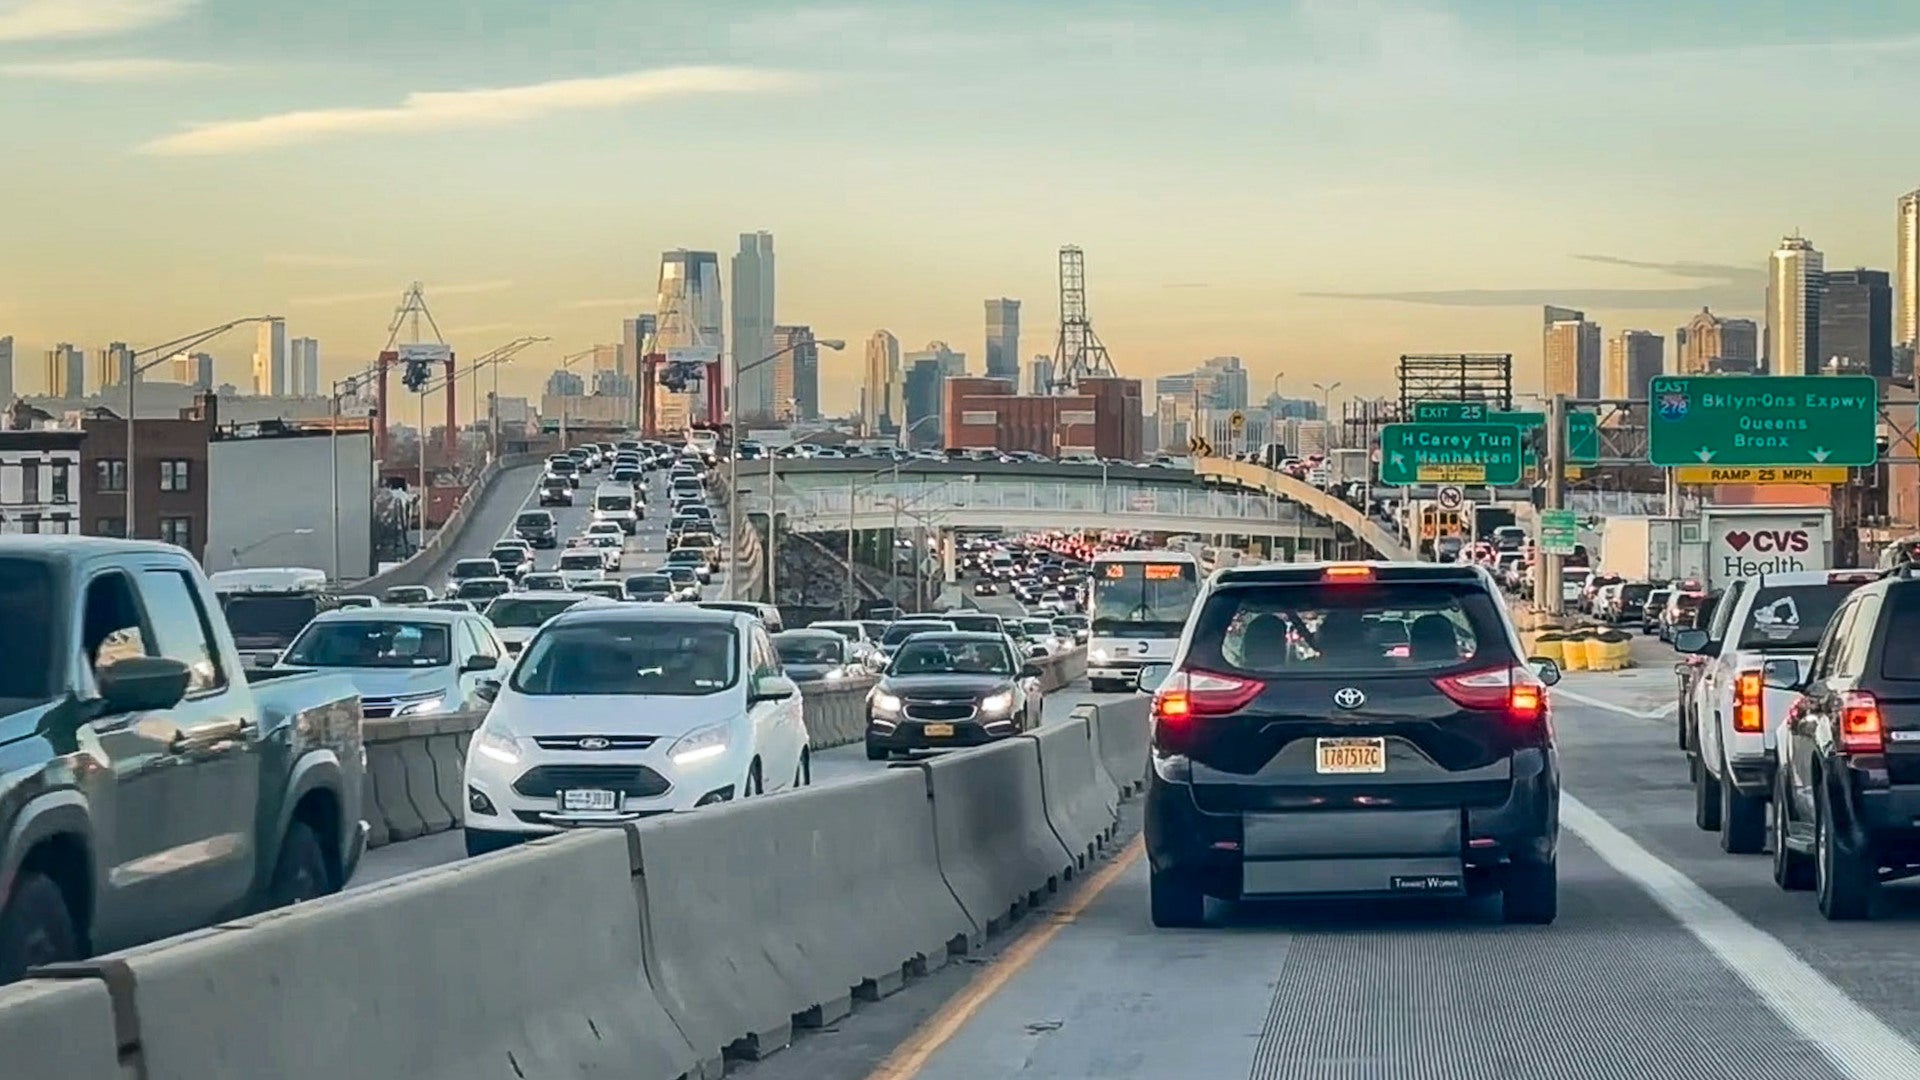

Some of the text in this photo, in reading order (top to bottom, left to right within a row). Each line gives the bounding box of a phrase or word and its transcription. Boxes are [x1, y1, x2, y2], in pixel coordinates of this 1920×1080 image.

[1655, 381, 1689, 392] EAST
[1660, 401, 1688, 414] 278
[1806, 394, 1866, 410] Expwy
[1420, 406, 1481, 419] EXIT 25
[1740, 416, 1807, 430] Queens
[1402, 432, 1512, 449] H Carey Tun
[1735, 434, 1789, 447] Bronx
[1415, 450, 1512, 464] Manhattan
[1711, 469, 1813, 481] RAMP 25 MPH
[1753, 530, 1809, 553] CVS
[1724, 556, 1804, 577] Health
